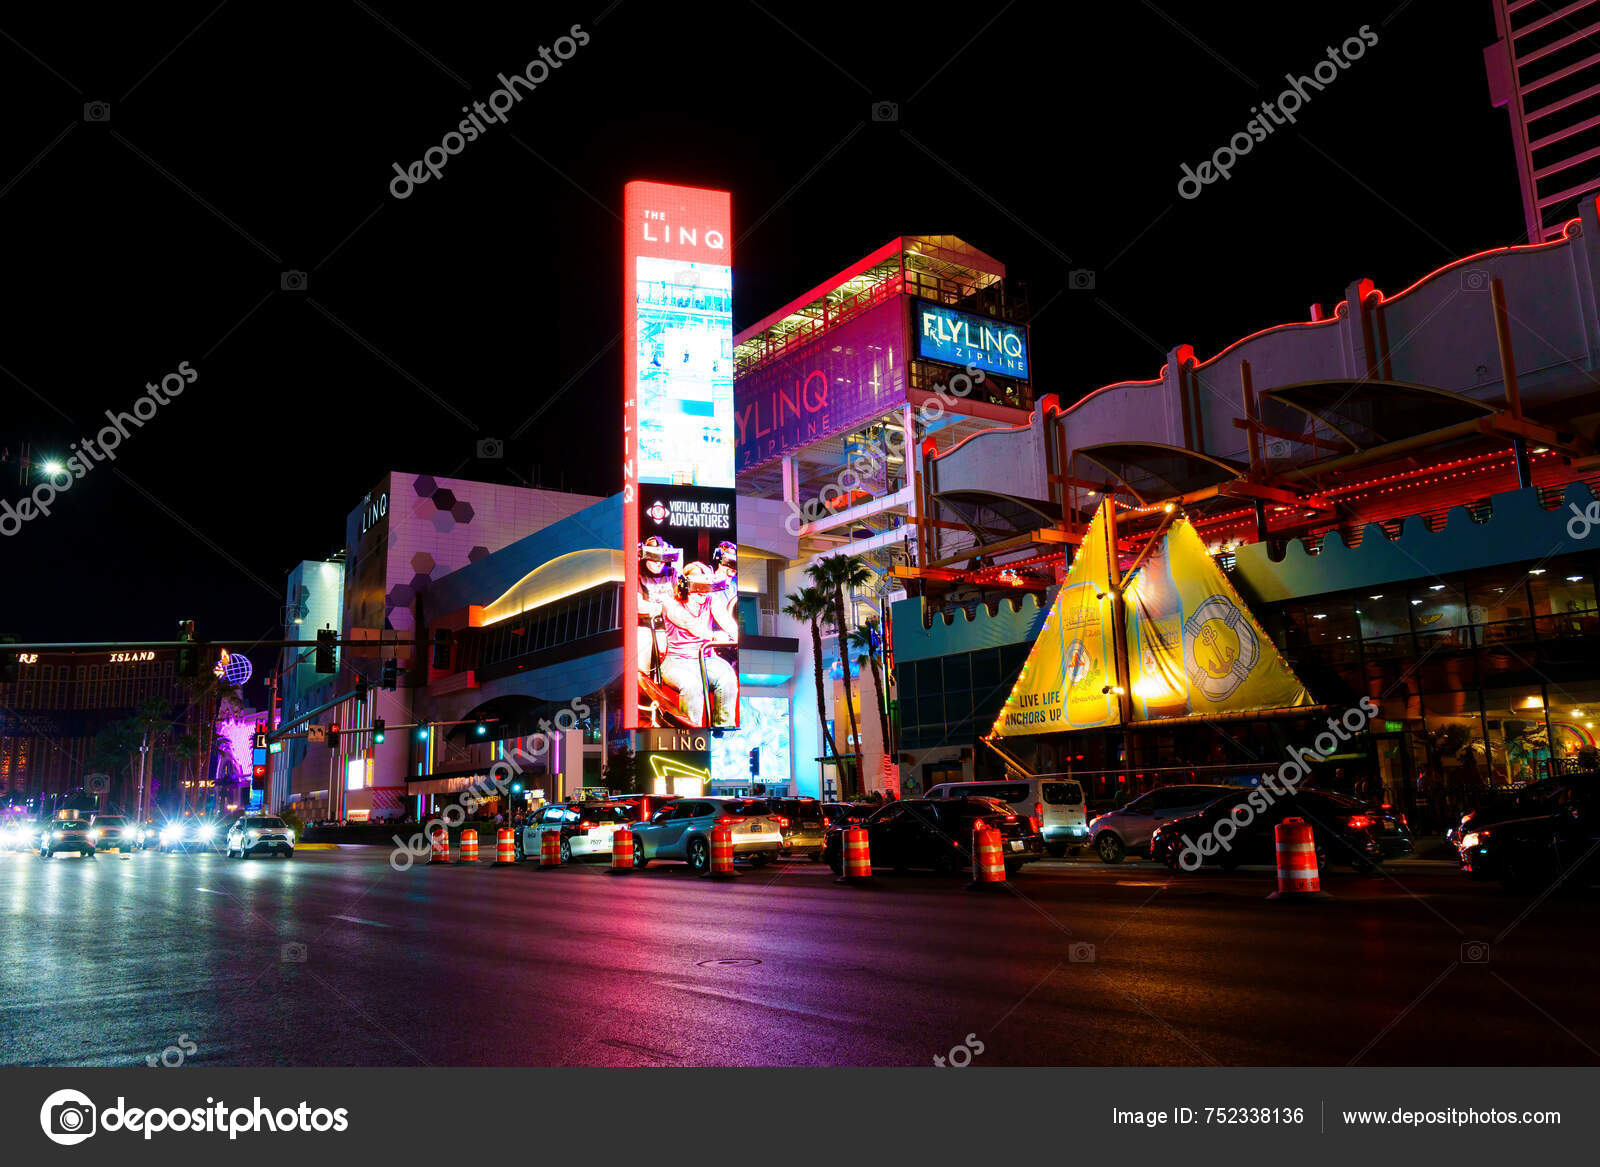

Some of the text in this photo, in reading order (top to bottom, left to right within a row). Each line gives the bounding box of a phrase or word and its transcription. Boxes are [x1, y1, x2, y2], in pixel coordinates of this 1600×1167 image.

[643, 209, 666, 221] THE
[643, 222, 725, 250] LINQ
[922, 312, 1023, 359] FLYLINQ
[955, 346, 1025, 372] ZIPLINE
[743, 414, 831, 466] ZIPLINE
[362, 493, 387, 534] LINQ
[669, 500, 730, 515] VIRTUAL REALITY
[669, 514, 730, 529] ADVENTURES
[109, 651, 156, 662] ISLAND
[1019, 694, 1039, 706] LIVE
[1042, 690, 1061, 704] LIFE
[1004, 708, 1062, 727] ANCHORS UP
[658, 736, 706, 751] LINQ
